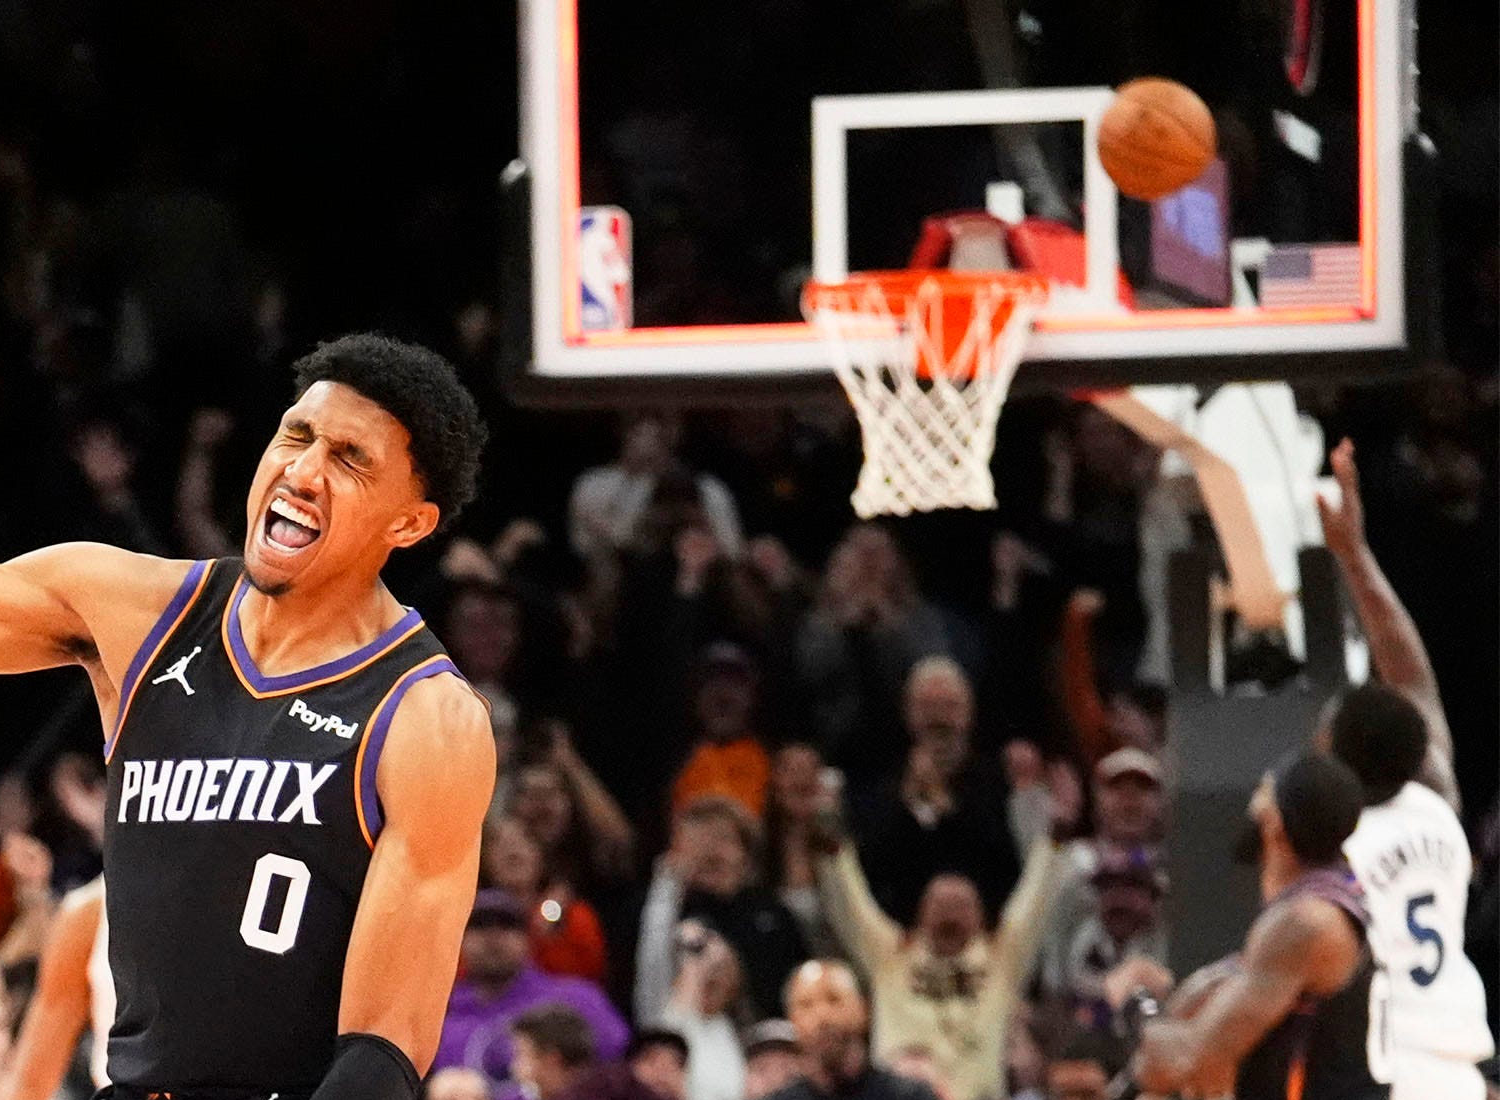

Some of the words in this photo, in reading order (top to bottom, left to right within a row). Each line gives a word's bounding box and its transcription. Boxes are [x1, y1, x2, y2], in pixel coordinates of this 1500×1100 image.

[288, 699, 359, 739] PayPal
[117, 757, 340, 825] PHOENIX
[239, 852, 312, 955] 0
[1406, 891, 1444, 987] 5
